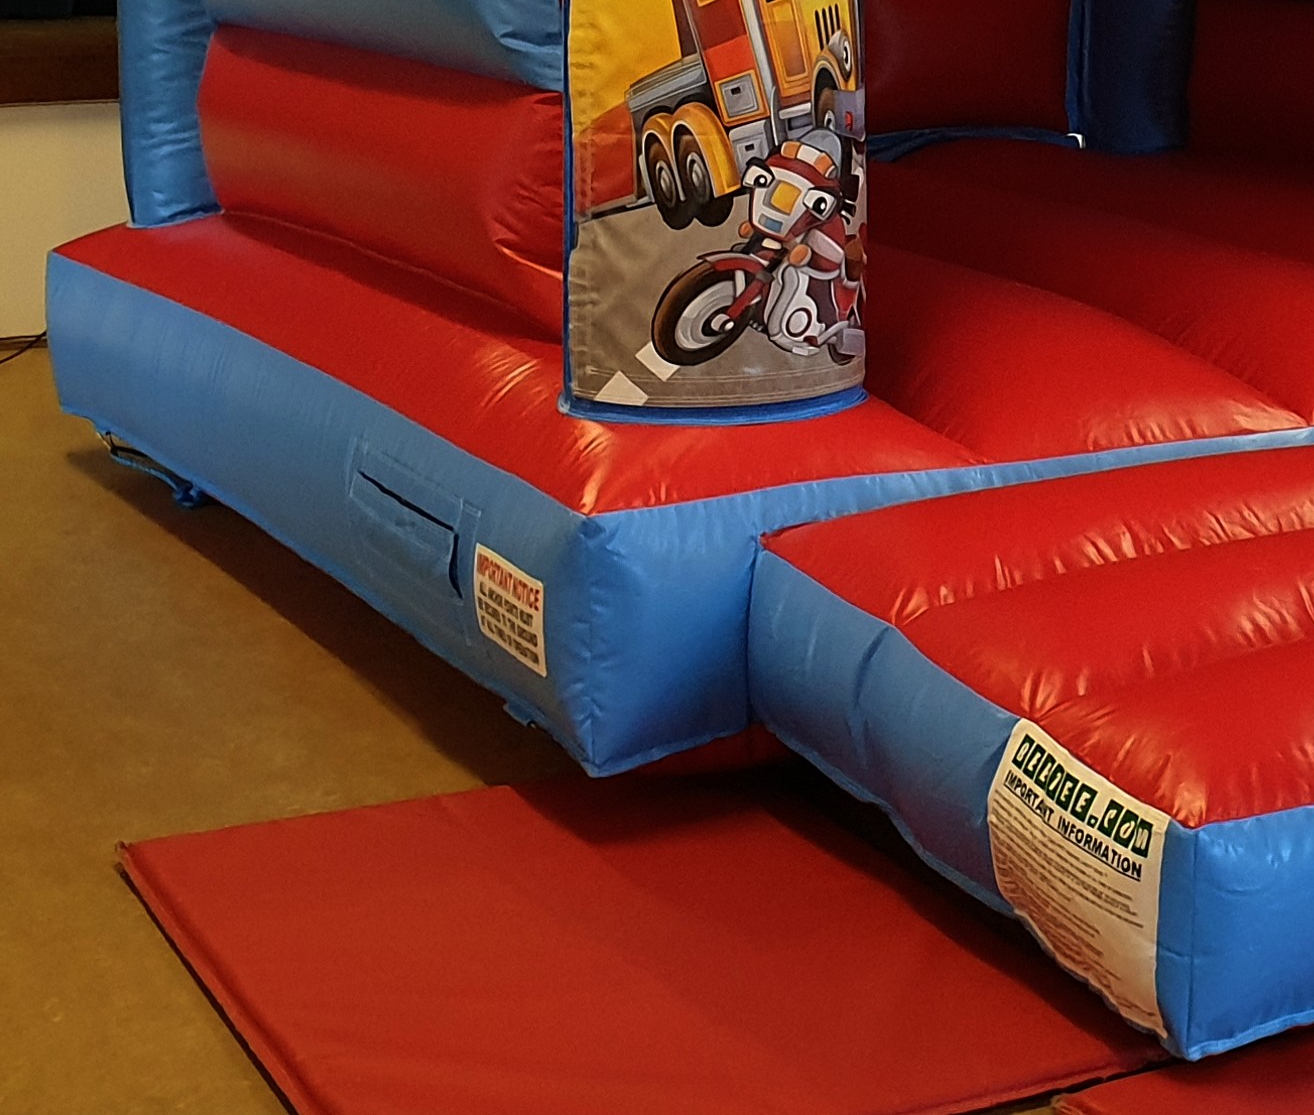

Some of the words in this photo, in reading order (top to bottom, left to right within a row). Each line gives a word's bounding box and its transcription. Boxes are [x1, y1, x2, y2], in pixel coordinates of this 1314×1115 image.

[512, 579, 540, 611] NOTICE
[1004, 770, 1055, 823] IMPORTANT
[1057, 815, 1143, 878] INFORMATION
